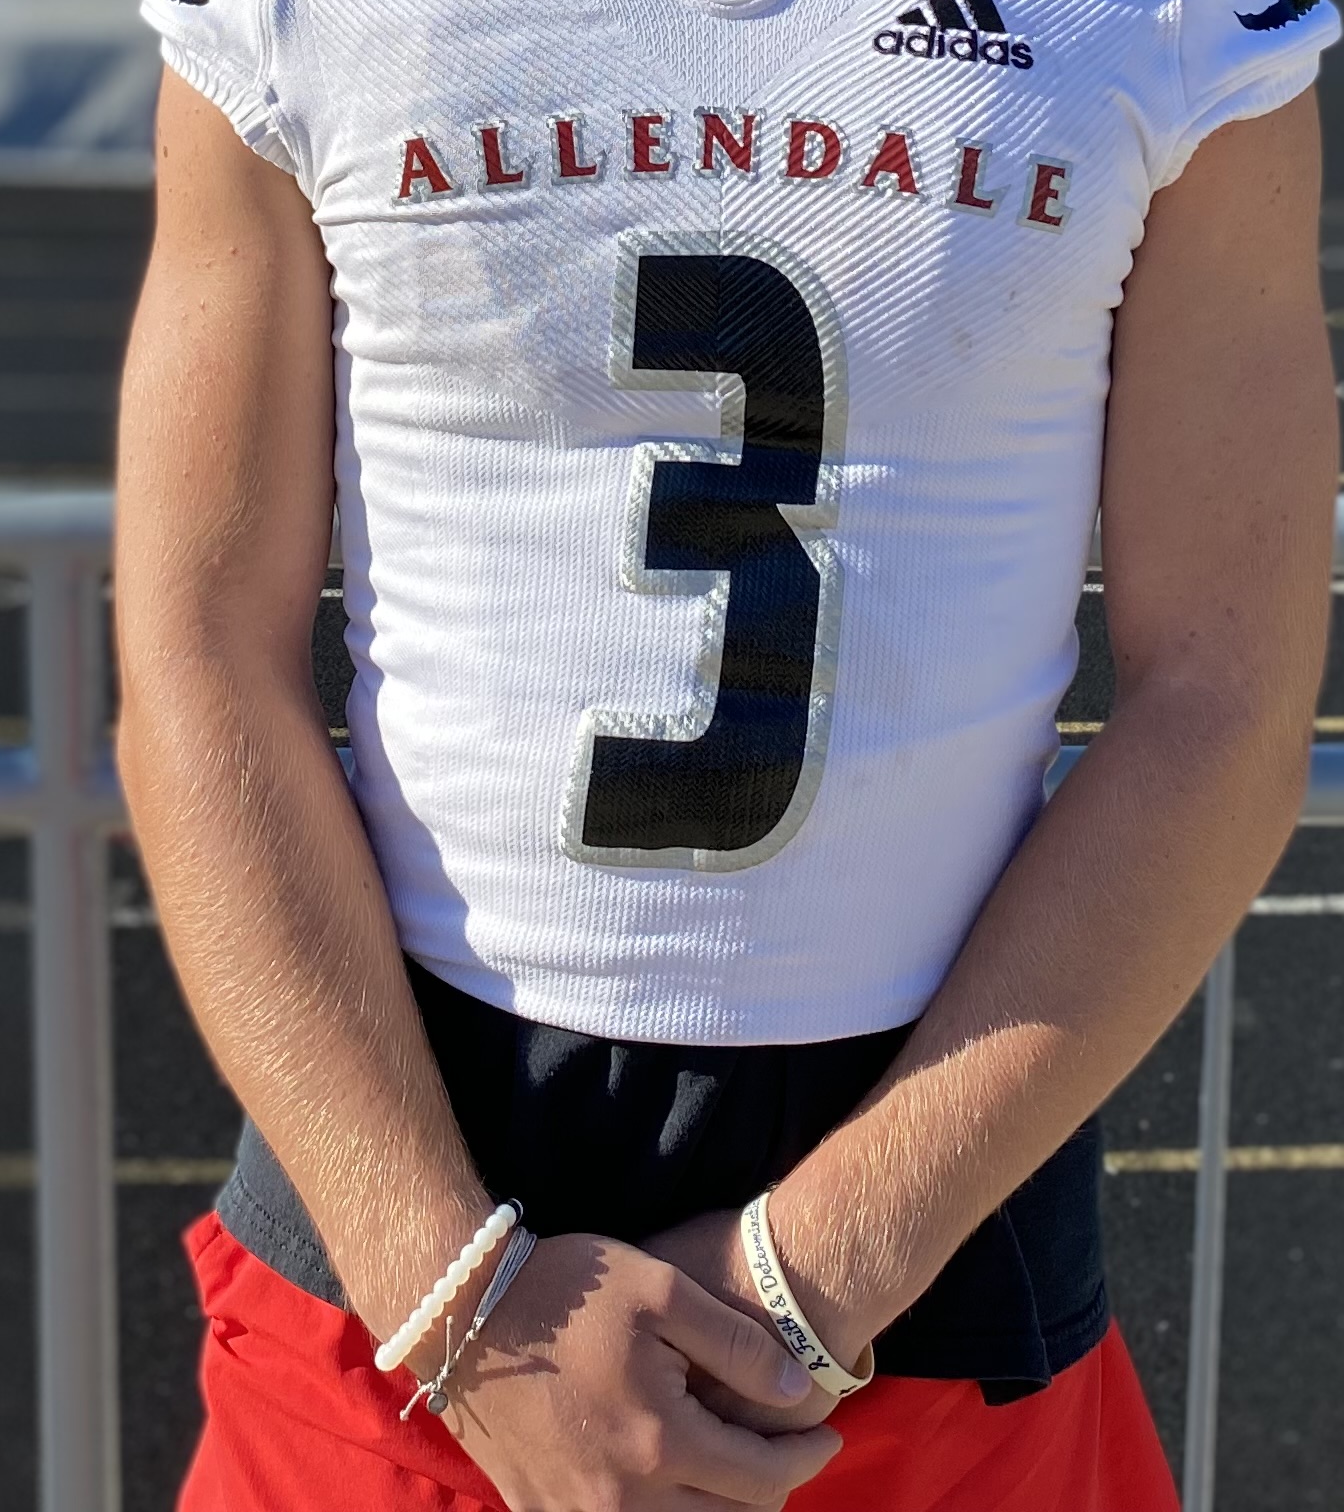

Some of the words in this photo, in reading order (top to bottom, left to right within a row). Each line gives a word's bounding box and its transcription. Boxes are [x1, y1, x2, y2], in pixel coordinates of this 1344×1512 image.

[873, 25, 1034, 70] adidas
[395, 108, 1073, 230] ALLENDALE
[560, 231, 848, 872] 3
[770, 1293, 787, 1308] &
[777, 1311, 815, 1355] Faith
